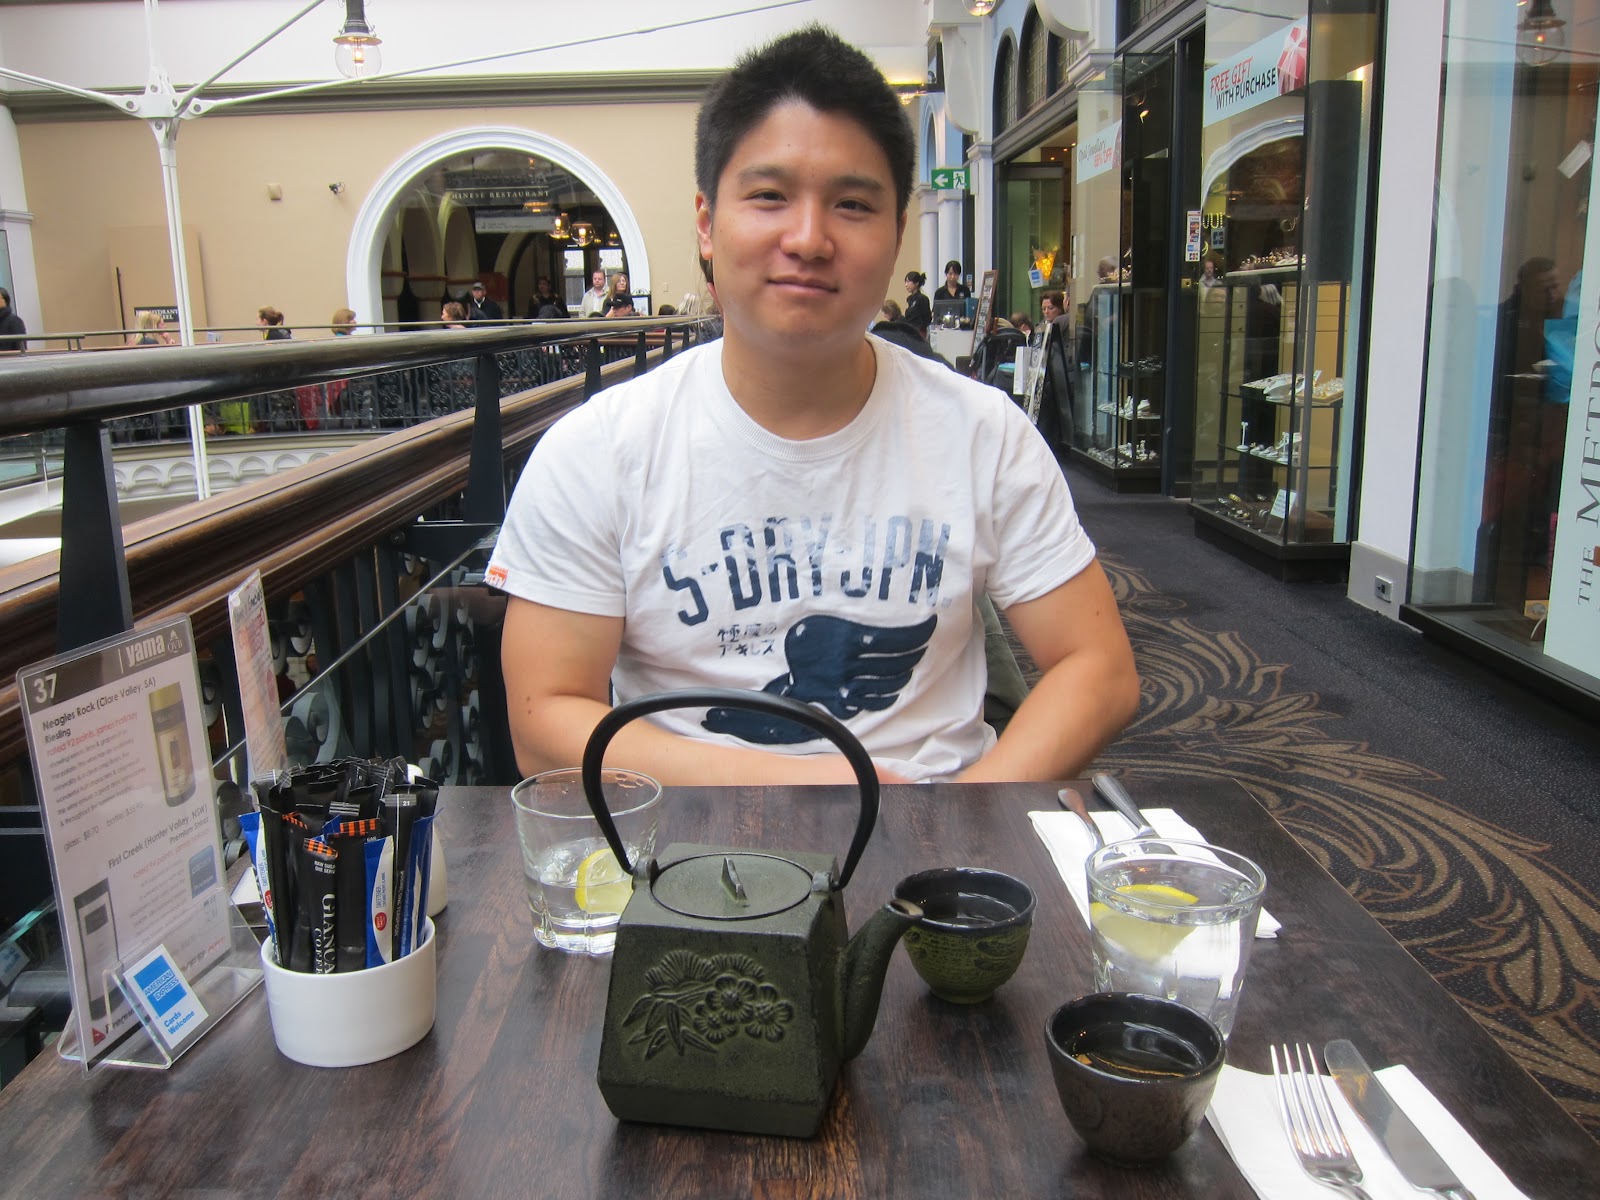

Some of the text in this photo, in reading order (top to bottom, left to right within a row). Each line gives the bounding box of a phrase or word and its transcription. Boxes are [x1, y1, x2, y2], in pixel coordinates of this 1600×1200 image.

[1210, 56, 1254, 98] FREE GIFT
[1215, 67, 1276, 110] WITH PURCHASE
[450, 190, 549, 200] HINESE RESTAURANT
[1576, 325, 1600, 527] MET
[1577, 546, 1595, 605] THE
[33, 673, 59, 704] 37
[125, 634, 166, 668] yama
[167, 639, 183, 653] QVB
[42, 711, 75, 732] Neagles
[76, 702, 95, 716] Rock
[96, 692, 118, 709] (Clare
[143, 676, 156, 690] SA)
[44, 727, 71, 745] Riesling
[46, 743, 65, 757] rated
[66, 738, 75, 748] 92
[108, 854, 121, 869] First
[122, 841, 143, 861] Creek
[144, 827, 168, 849] (Hunter
[191, 803, 207, 820] NSW)
[169, 825, 193, 844] Premium
[144, 969, 174, 997] AMERICAN
[155, 977, 180, 1001] EXPRESS
[164, 1011, 182, 1027] Cards
[168, 1011, 195, 1034] Welcome
